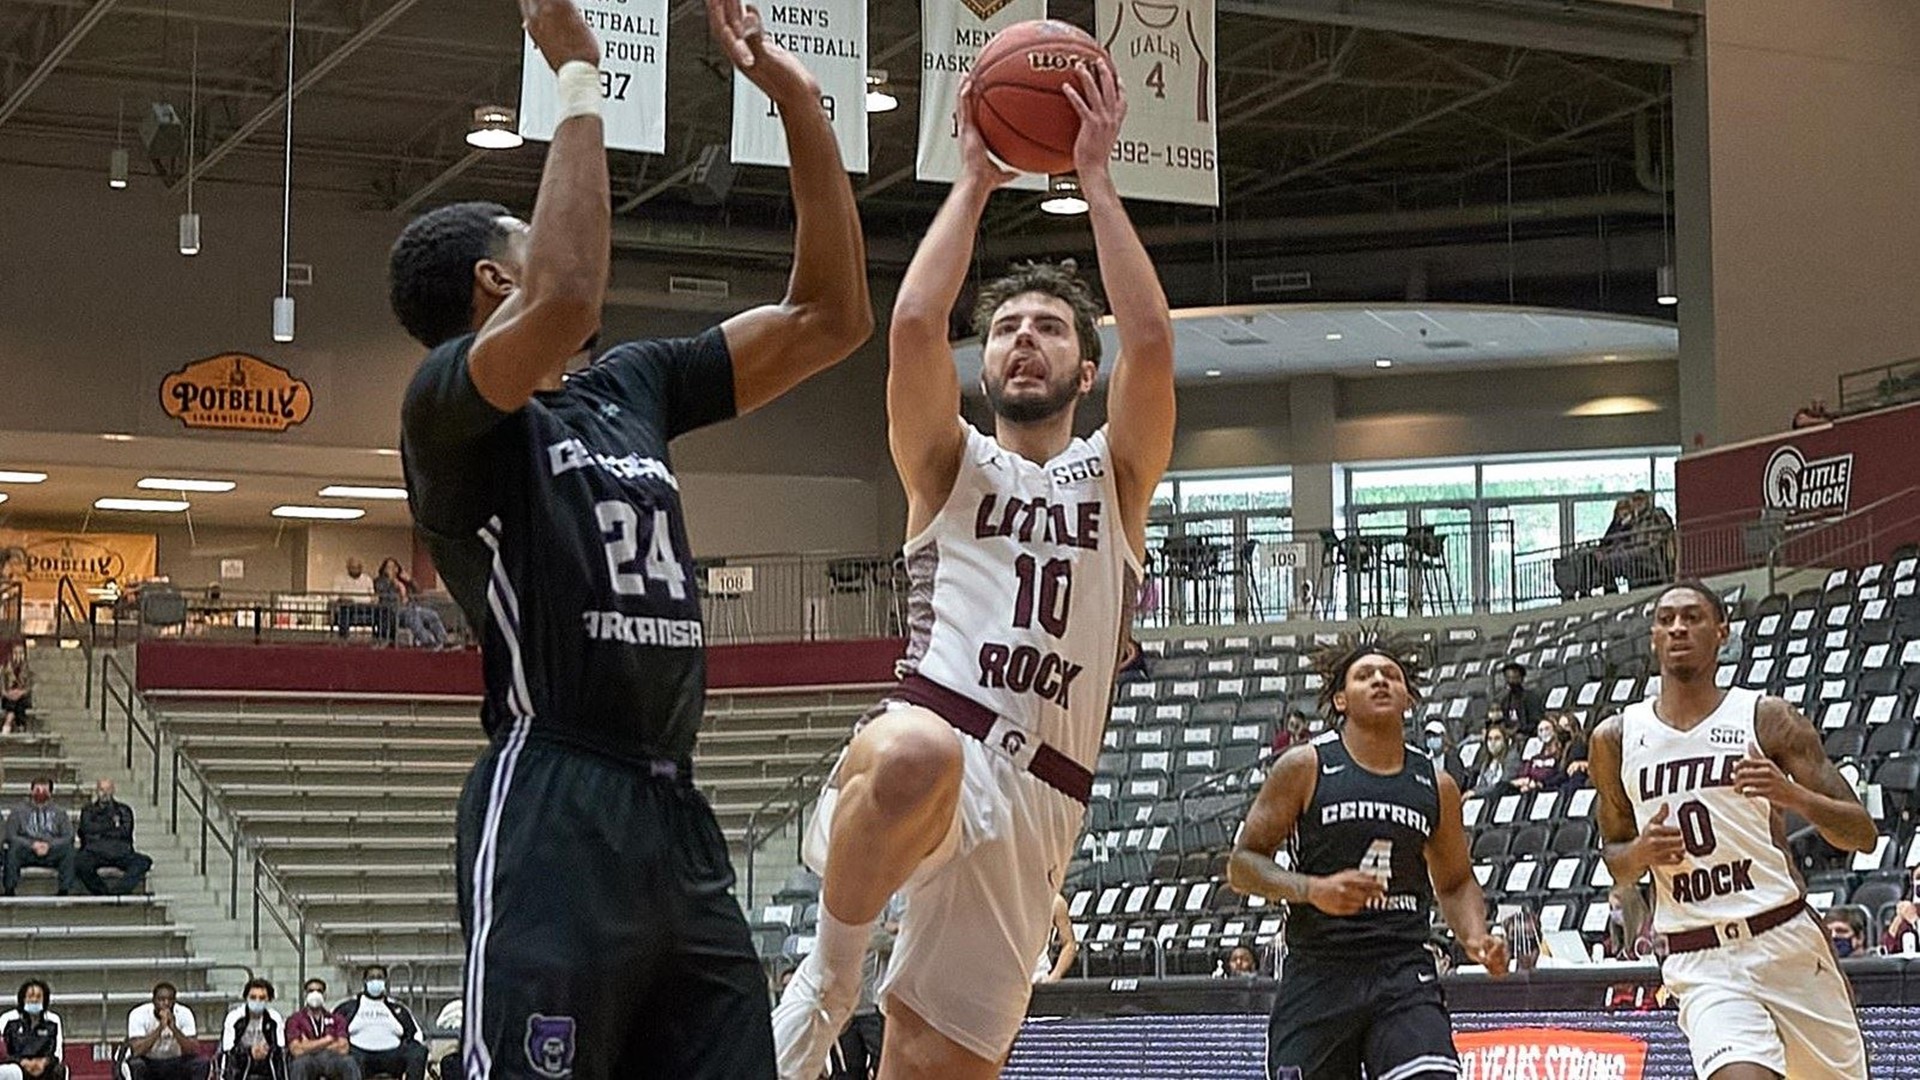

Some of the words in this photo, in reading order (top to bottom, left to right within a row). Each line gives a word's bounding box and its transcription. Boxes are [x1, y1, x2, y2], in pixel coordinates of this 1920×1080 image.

[577, 9, 660, 37] ETBALL
[771, 5, 829, 28] MEN'S
[605, 40, 655, 63] FOUR
[767, 31, 860, 59] KETBALL
[1131, 34, 1180, 66] UALR
[923, 52, 977, 73] BASK
[1145, 61, 1165, 99] 4
[172, 382, 299, 418] POTBELLY
[1802, 462, 1847, 490] LITTLE
[1800, 484, 1844, 509] ROCK
[975, 494, 1102, 550] LITTLE
[595, 501, 686, 599] 24
[1272, 553, 1296, 567] 109
[720, 577, 743, 590] 108
[1012, 552, 1073, 639] 10
[978, 642, 1083, 710] ROCK
[1639, 753, 1744, 801] LITTLE
[1321, 801, 1431, 837] CENTRAL
[1677, 800, 1717, 857] 0
[1359, 839, 1393, 891] 4
[1672, 859, 1755, 903] ROCK
[1457, 1049, 1477, 1080] 0
